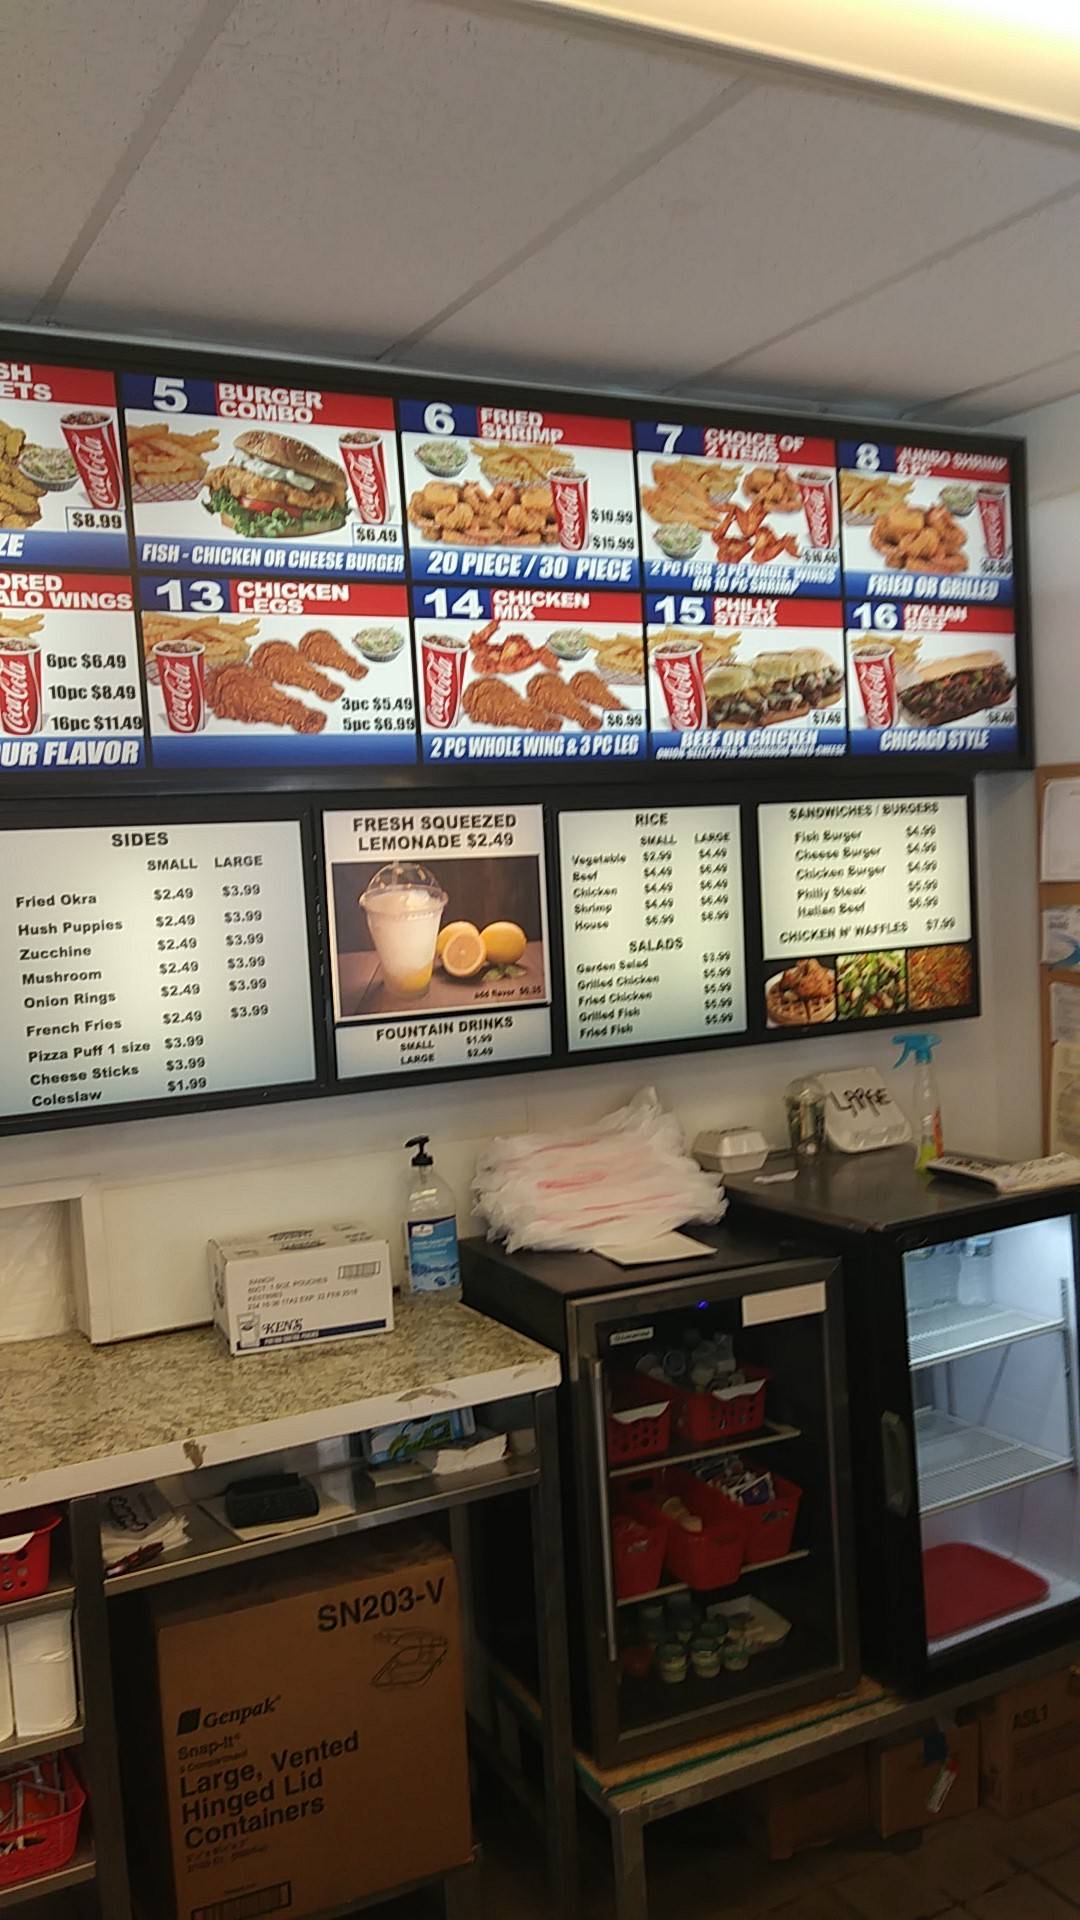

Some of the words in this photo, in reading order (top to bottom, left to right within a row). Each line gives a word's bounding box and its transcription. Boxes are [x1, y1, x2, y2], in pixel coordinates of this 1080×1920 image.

[153, 376, 188, 413] 5
[218, 383, 323, 410] BURGER
[220, 401, 314, 424] COMBO
[424, 402, 455, 435] 6
[481, 407, 543, 427] FRIED
[481, 424, 564, 443] SHRIMP
[656, 424, 683, 455] 7
[705, 428, 777, 448] CHOICE
[779, 435, 805, 453] OF
[856, 443, 880, 471] 8
[72, 512, 122, 529] $8.99
[355, 526, 398, 543] $6.49
[142, 543, 180, 563] FISH
[191, 545, 262, 567] CHICKEN
[264, 549, 286, 568] OR
[287, 550, 344, 570] CHEESE
[345, 553, 405, 573] BURGER
[427, 551, 458, 575] 20
[461, 552, 522, 578] PIECE
[538, 557, 568, 579] 30
[574, 558, 633, 583] PIECE
[682, 561, 714, 578] FISH
[794, 567, 837, 585] WINGS
[156, 579, 224, 613] 13
[236, 581, 350, 601] CHICKEN
[749, 578, 801, 596] SHRIMP
[866, 574, 915, 597] FRIED
[914, 576, 939, 599] OR
[938, 578, 1000, 601] GRILLED
[48, 592, 134, 610] WINGS
[238, 598, 304, 614] LEGS
[424, 588, 483, 619] 14
[493, 590, 591, 609] CHICKEN
[713, 597, 780, 613] PHILLY
[494, 605, 536, 620] MIX
[655, 595, 706, 625] 15
[714, 611, 779, 627] STEAK
[853, 602, 898, 630] 16
[46, 654, 78, 670] 6pc
[81, 653, 127, 669] $6.49
[49, 685, 88, 701] 10pc
[91, 685, 136, 700] $8.49
[341, 697, 369, 711] 3pc
[51, 716, 95, 732] 16pc
[94, 716, 144, 731] $11.49
[343, 717, 371, 732] 5pc
[430, 737, 442, 758] 2
[443, 736, 467, 758] PC
[468, 735, 521, 758] WHOLE
[523, 735, 565, 758] WING
[565, 737, 579, 755] &
[579, 735, 592, 757] 3
[591, 735, 613, 756] PC
[613, 734, 639, 755] LEG
[681, 730, 720, 747] BEEF
[721, 730, 745, 747] OR
[747, 729, 819, 747] CHICKEN
[880, 730, 946, 752] CHICAGO
[948, 730, 990, 750] STYLE
[42, 740, 140, 768] FLAVOR
[635, 813, 669, 827] RICE
[789, 804, 873, 821] SANDWICHES
[882, 801, 939, 816] BURGERS
[353, 816, 414, 832] FRESH
[420, 813, 518, 831] SQUEEZED
[111, 832, 169, 847] SIDES
[358, 833, 462, 851] LEMONADE
[467, 832, 514, 848] $2.49
[640, 834, 677, 847] SMALL
[694, 832, 731, 844] LARGE
[147, 858, 198, 871] SMALL
[214, 854, 263, 868] LARGE
[572, 853, 627, 867] Vegetable
[573, 870, 598, 882] Beef
[16, 895, 55, 908] Fried
[61, 893, 97, 906] Okra
[153, 887, 194, 901] $2.49
[222, 884, 261, 898] $3.99
[573, 886, 618, 899] Chicken
[574, 902, 613, 915] Shrimp
[18, 922, 57, 936] Hush
[63, 919, 123, 935] Puppies
[155, 914, 195, 928] $2.49
[224, 910, 262, 924] $3.99
[575, 919, 609, 932] House
[780, 927, 836, 944] CHICKEN
[855, 921, 909, 937] WAFFLES
[19, 945, 92, 961] Zucchine
[157, 937, 197, 951] $2.49
[225, 932, 264, 946] $3.99
[629, 937, 684, 954] SALADS
[22, 970, 102, 985] Mushroom
[159, 961, 199, 974] $2.49
[227, 955, 266, 969] $3.99
[576, 962, 615, 975] Garden
[619, 958, 649, 970] Salad
[577, 977, 613, 991] Grilled
[616, 974, 660, 987] Chicken
[24, 995, 69, 1008] Onion
[74, 992, 117, 1006] Rings
[160, 983, 200, 997] $2.49
[229, 978, 267, 992] $3.99
[578, 994, 606, 1008] Fried
[609, 990, 653, 1004] Chicken
[26, 1022, 80, 1037] French
[85, 1019, 122, 1033] Fries
[163, 1010, 202, 1024] $2.49
[230, 1004, 269, 1018] $3.99
[579, 1009, 615, 1023] Grilled
[618, 1007, 640, 1019] Fish
[376, 1022, 454, 1041] FOUNTAIN
[458, 1015, 514, 1033] DRINKS
[579, 1026, 607, 1040] Fried
[610, 1023, 633, 1036] Fish
[28, 1050, 68, 1063] Pizza
[73, 1043, 104, 1058] Puff
[107, 1043, 116, 1055] 1
[121, 1041, 151, 1054] size
[164, 1034, 204, 1049] $3.99
[400, 1040, 434, 1051] SMALL
[400, 1053, 435, 1065] LARGE
[30, 1070, 88, 1086] Cheese
[92, 1064, 140, 1079] Sticks
[166, 1057, 205, 1071] $3.99
[32, 1090, 102, 1107] Coleslaw
[167, 1077, 207, 1092] $1.99
[317, 1576, 446, 1633] SN203-V
[203, 1697, 278, 1729] Genpak
[180, 1765, 263, 1799] Large,
[271, 1730, 359, 1774] Vented
[182, 1783, 275, 1825] Hinged
[284, 1766, 324, 1796] Lid
[184, 1796, 326, 1850] Containers
